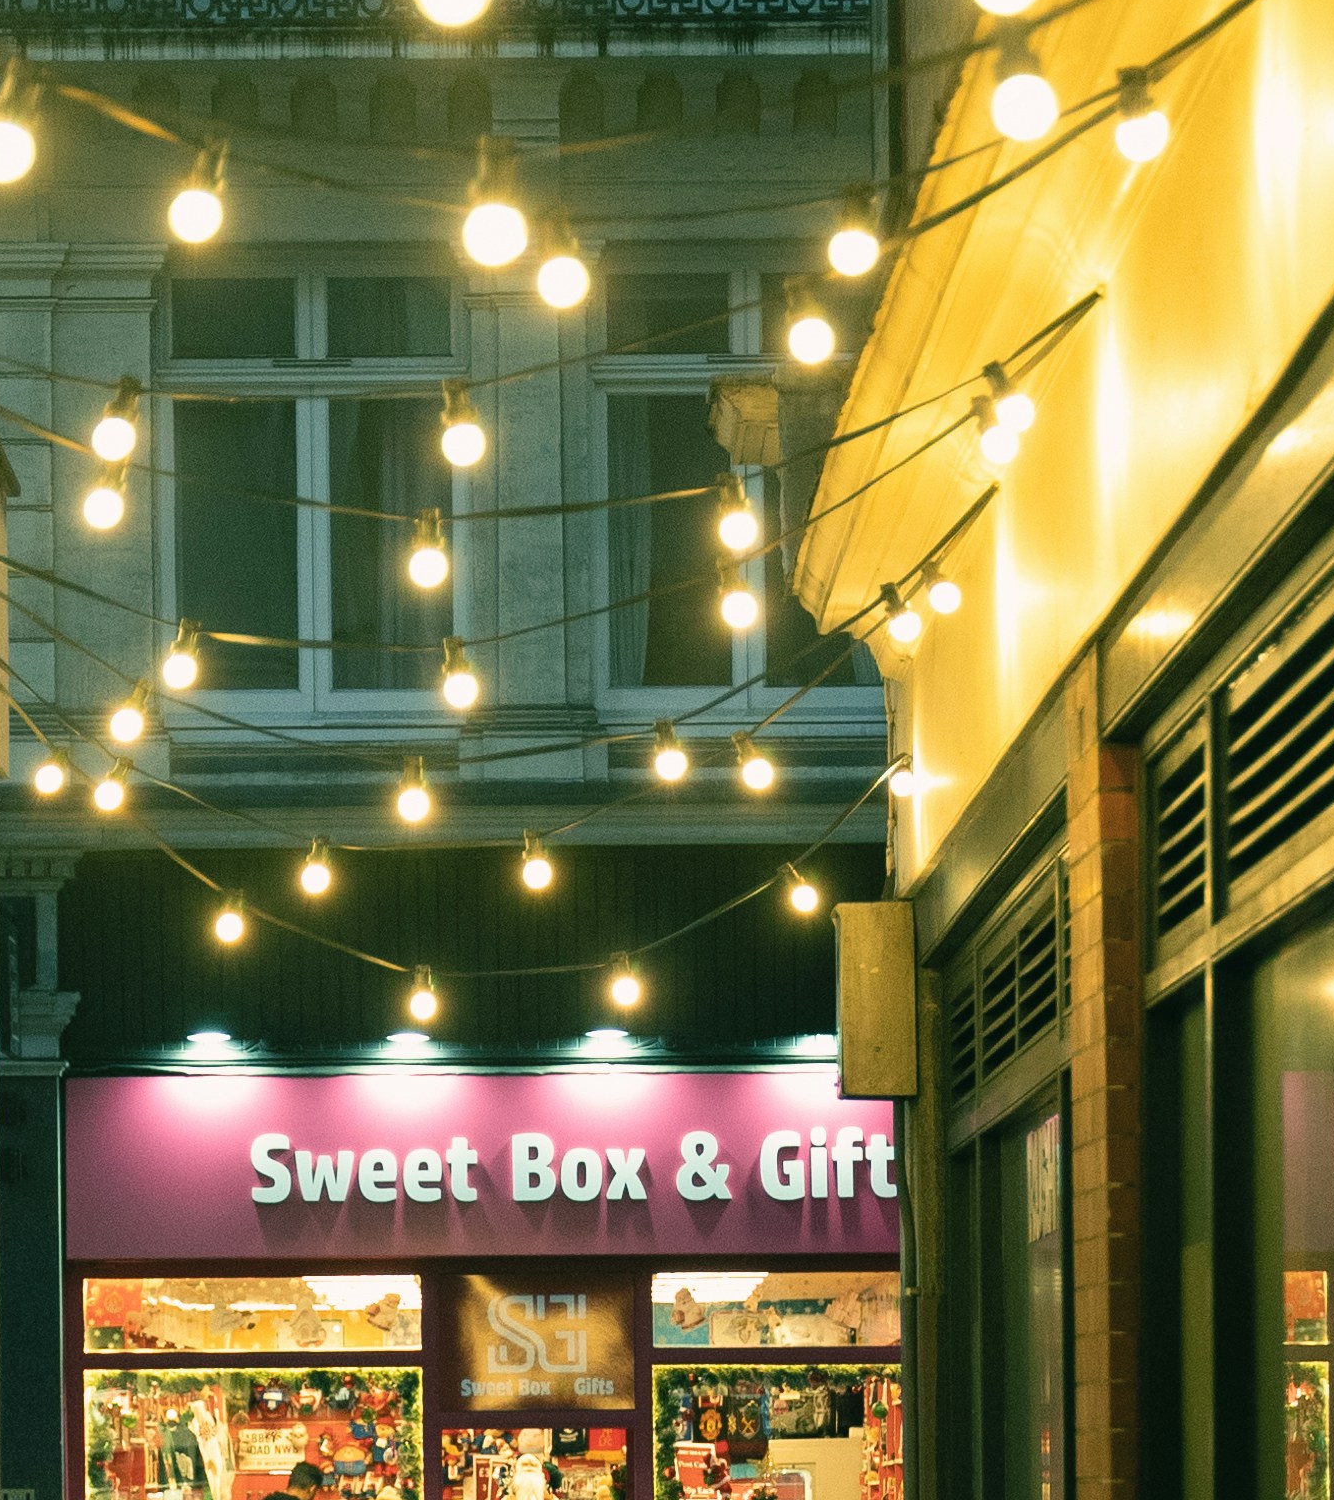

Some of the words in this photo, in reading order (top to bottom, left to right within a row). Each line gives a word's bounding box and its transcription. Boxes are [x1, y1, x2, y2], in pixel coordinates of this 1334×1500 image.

[250, 1133, 477, 1203] Sweet
[511, 1132, 647, 1202] Box
[675, 1130, 732, 1200] &
[760, 1126, 897, 1200] Gift
[460, 1378, 513, 1396] Sweet
[519, 1379, 551, 1396] Box
[574, 1377, 615, 1395] Gifts
